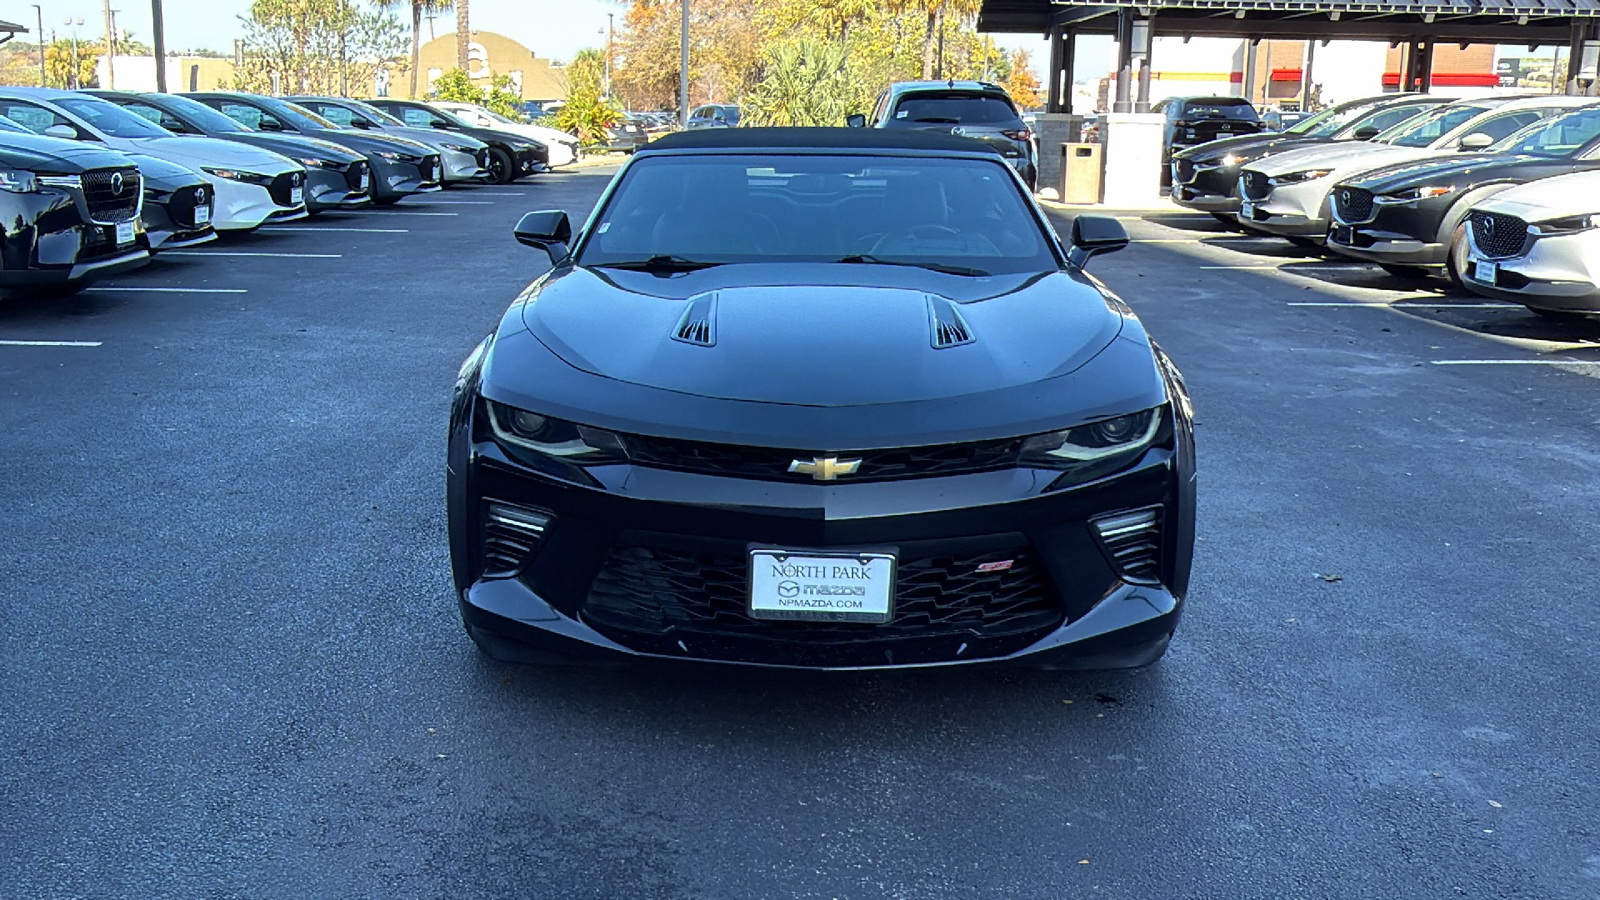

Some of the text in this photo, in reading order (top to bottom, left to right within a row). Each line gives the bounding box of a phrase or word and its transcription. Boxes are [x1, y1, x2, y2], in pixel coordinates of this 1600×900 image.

[771, 563, 872, 580] NORTH PARK
[803, 584, 866, 596] mazda
[778, 598, 863, 609] NPMAZDA.COM
